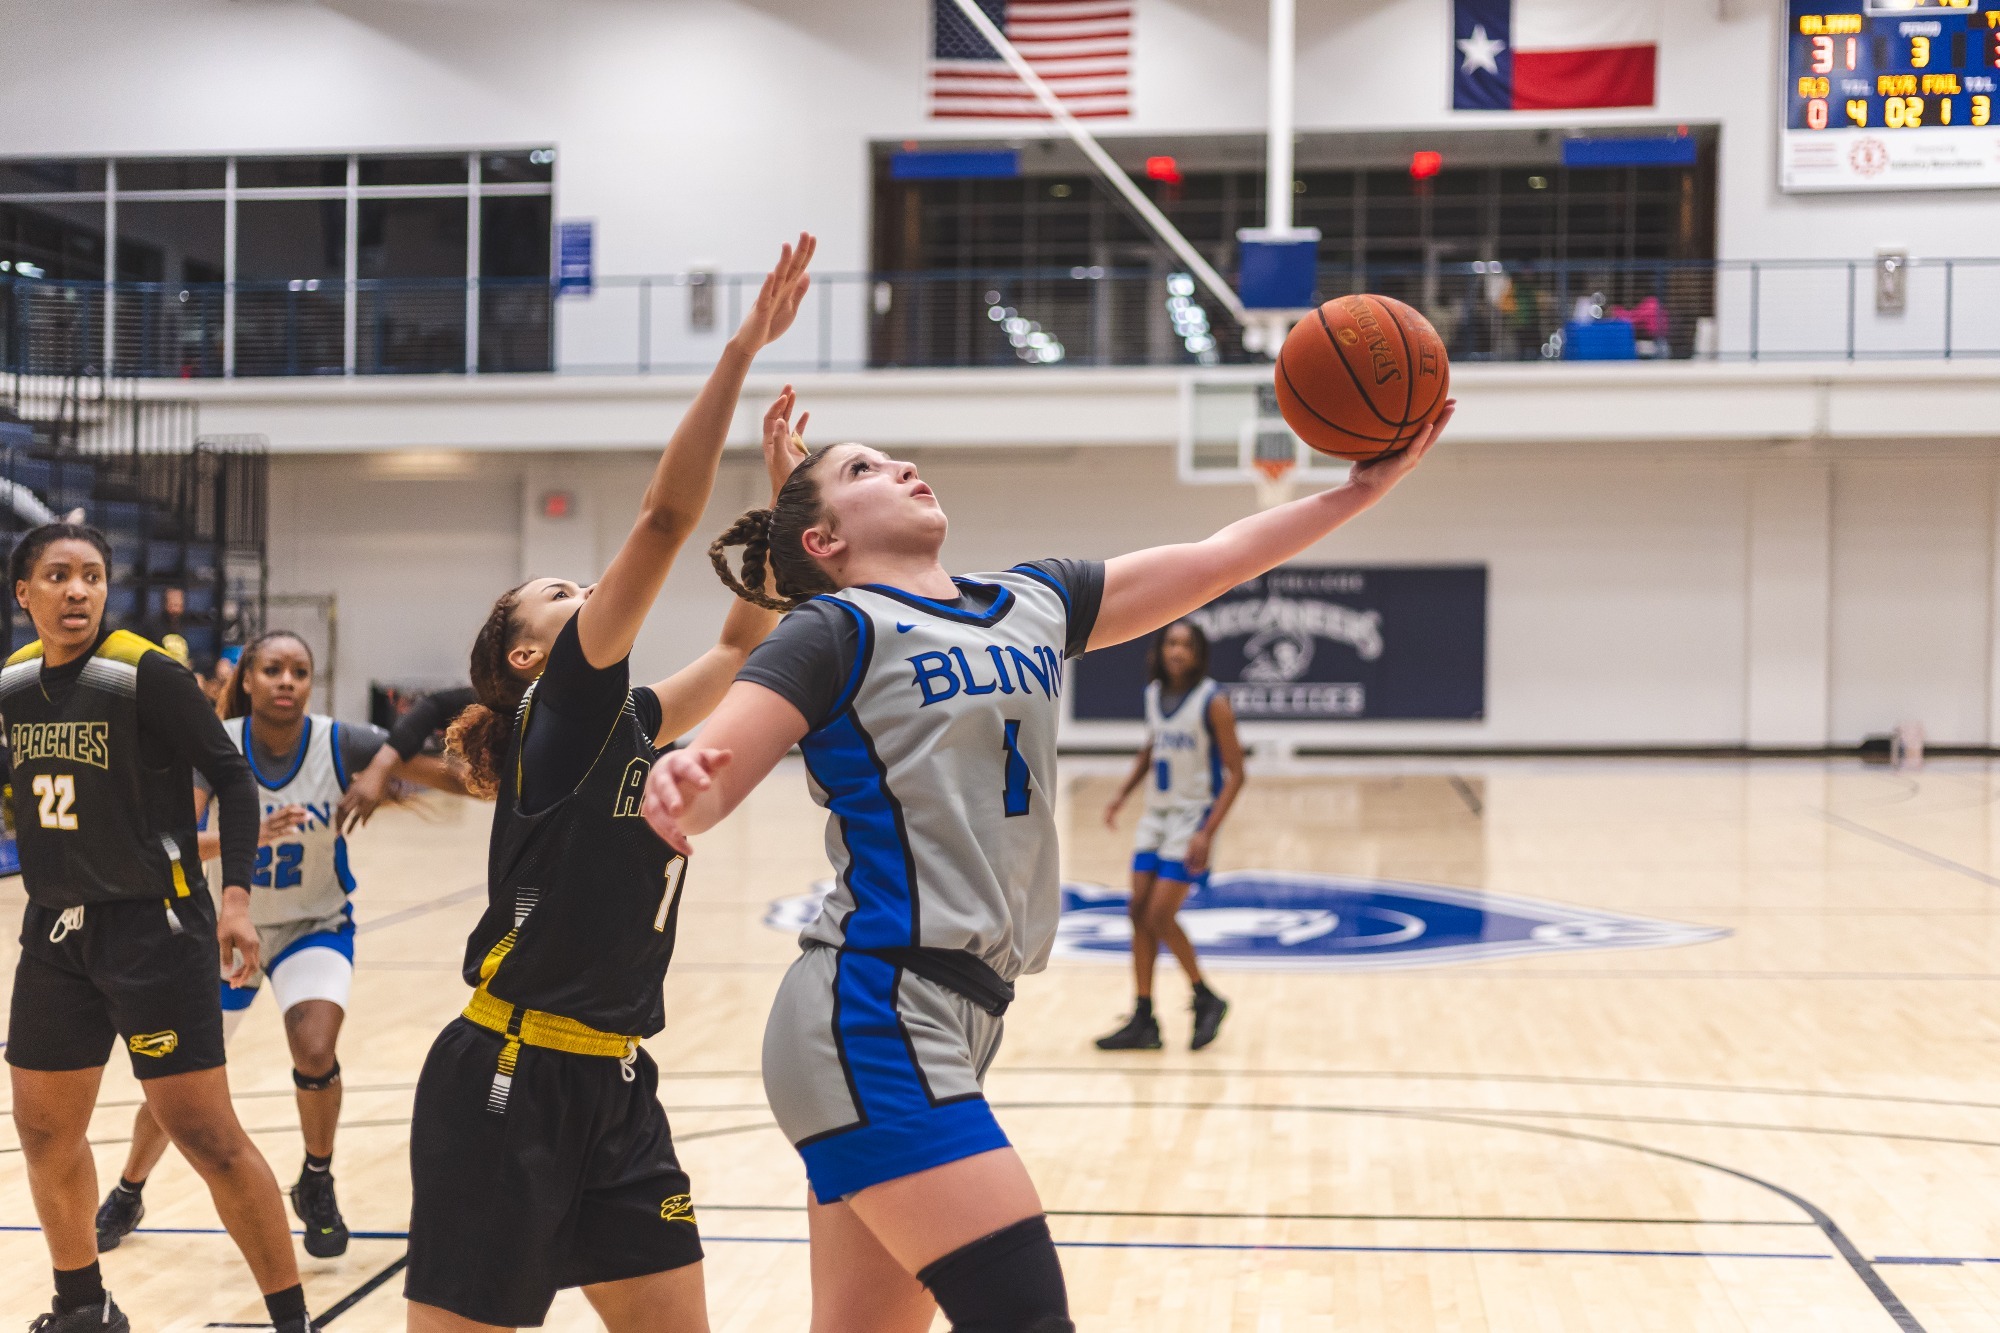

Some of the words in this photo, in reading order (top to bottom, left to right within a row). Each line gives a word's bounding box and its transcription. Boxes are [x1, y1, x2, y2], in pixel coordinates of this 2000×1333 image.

[1911, 37, 1930, 68] 3
[1807, 99, 1828, 130] 0
[1846, 99, 1867, 127] 4
[1885, 96, 1924, 128] 02
[1940, 98, 1951, 126] 1
[1971, 95, 1990, 126] 3
[904, 645, 1064, 708] BLINN
[1002, 719, 1032, 818] 1
[32, 774, 78, 831] 22
[252, 843, 304, 889] 22
[654, 855, 684, 932] 1
